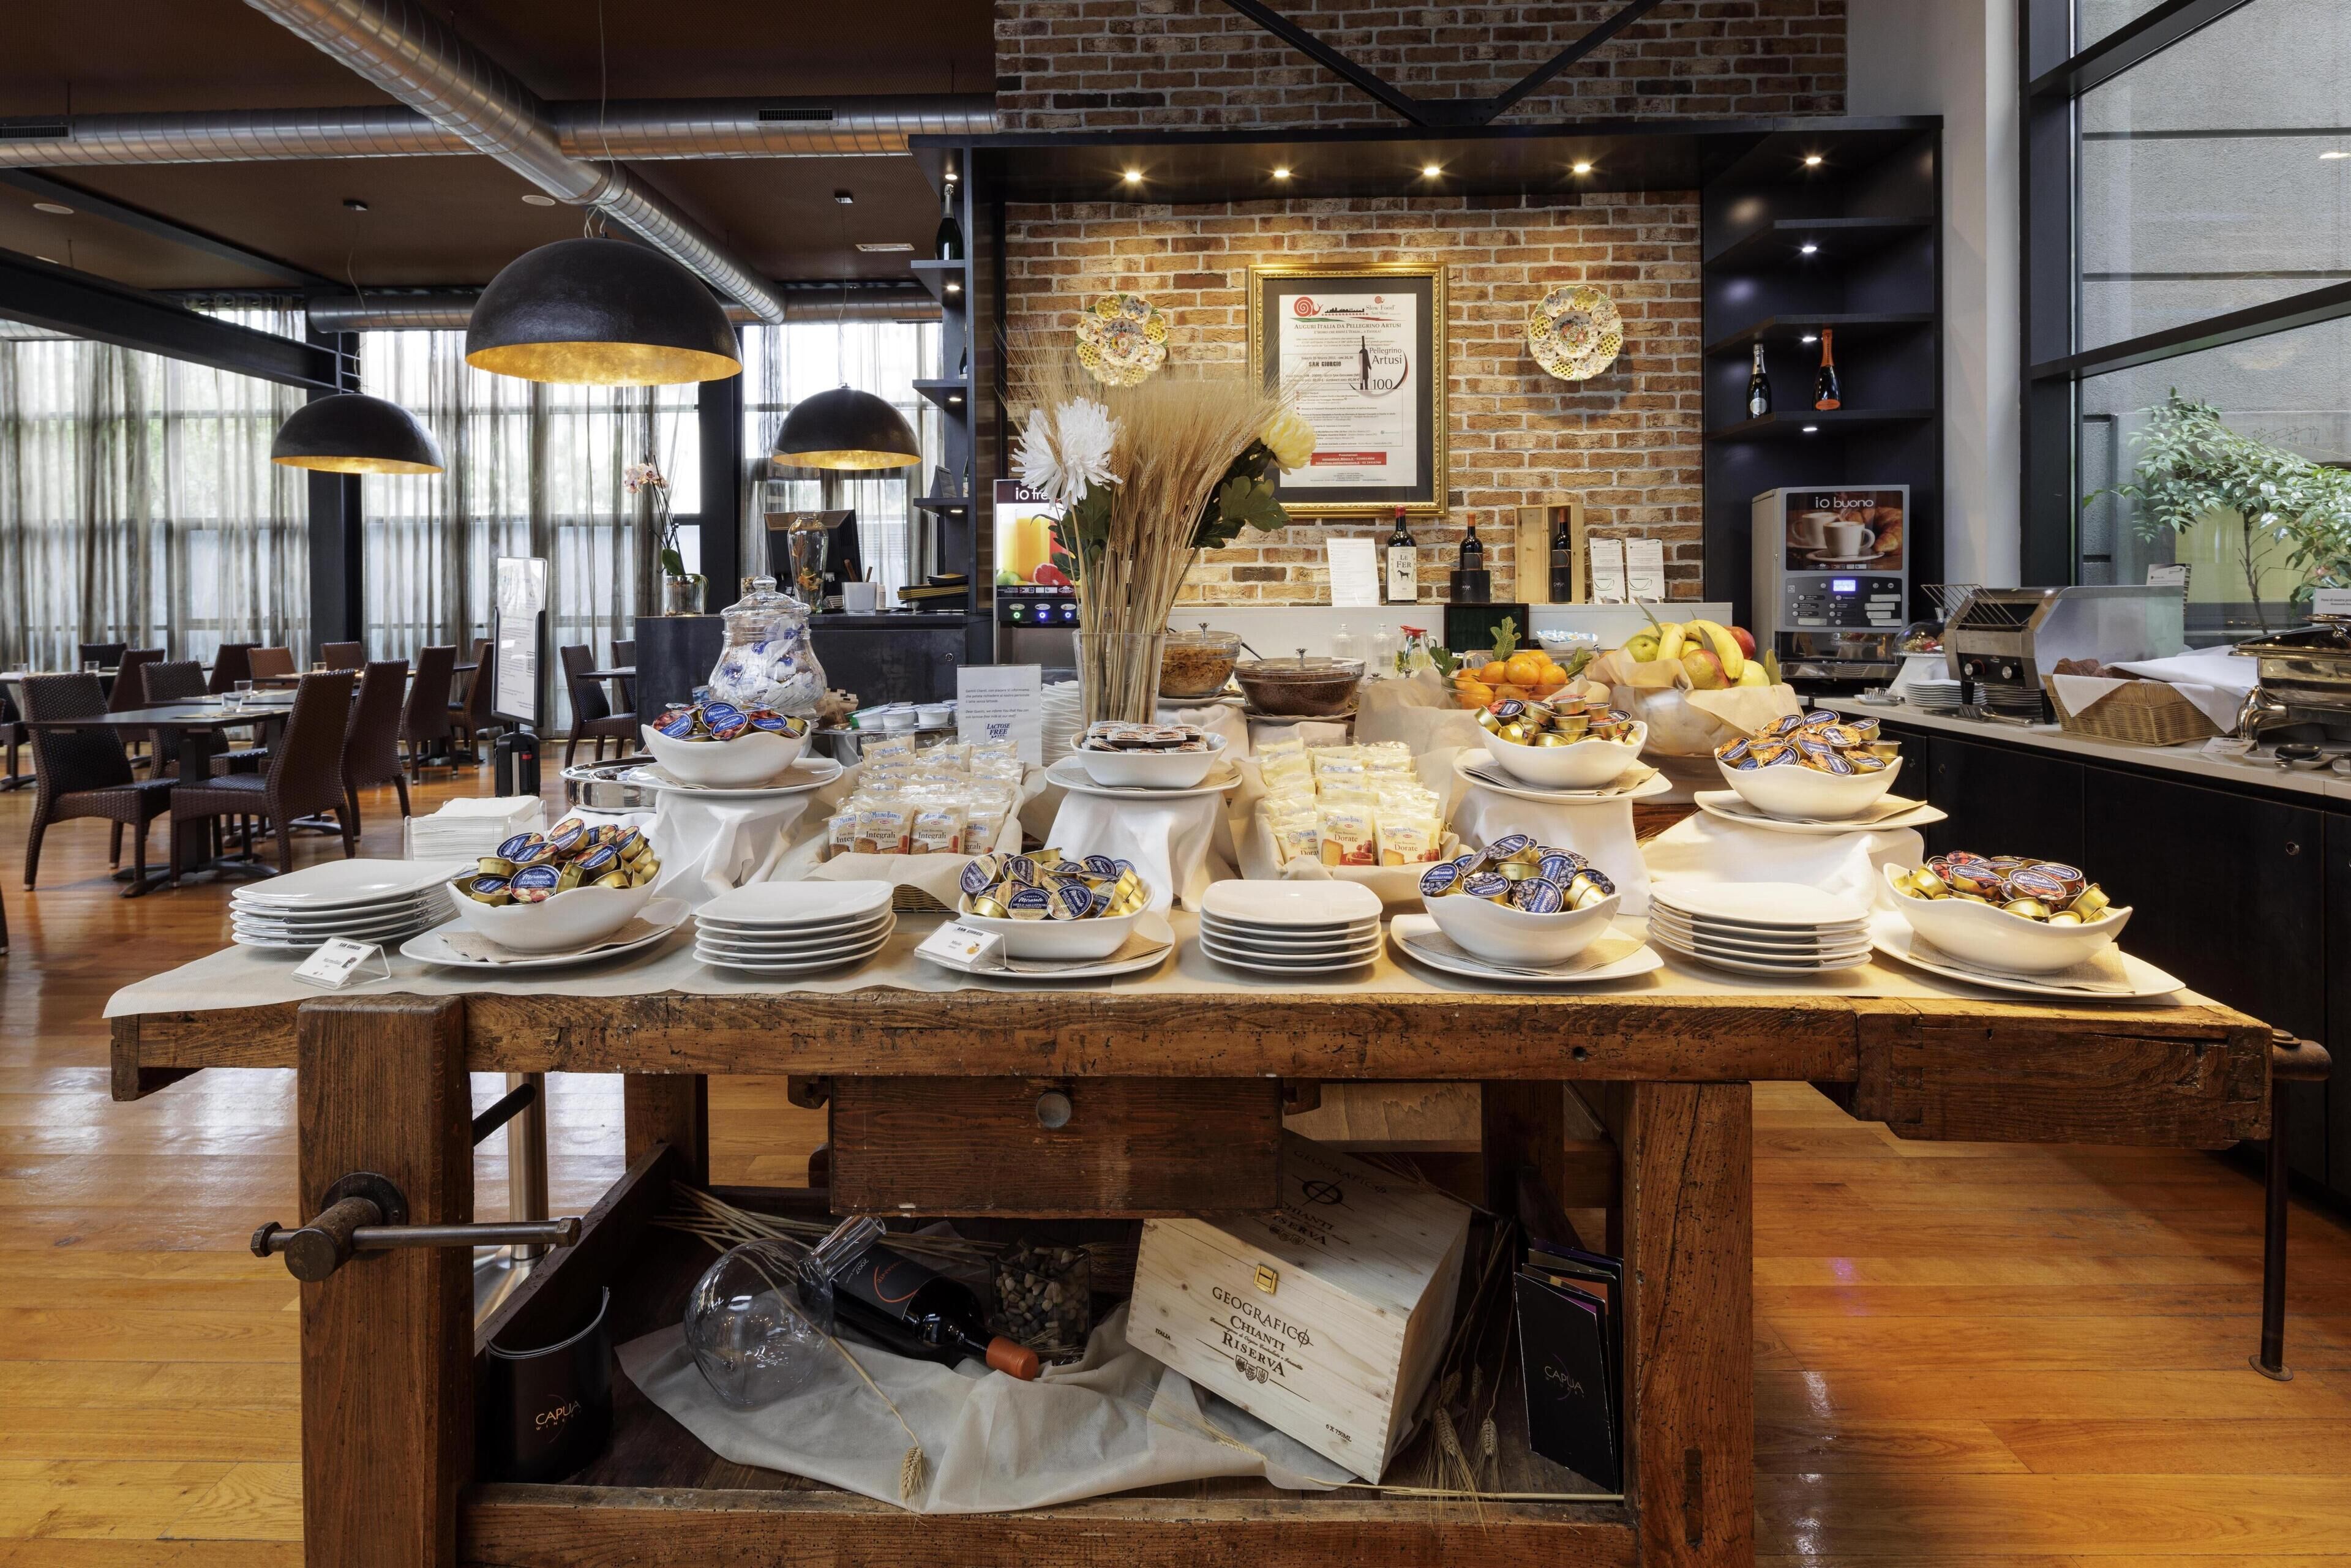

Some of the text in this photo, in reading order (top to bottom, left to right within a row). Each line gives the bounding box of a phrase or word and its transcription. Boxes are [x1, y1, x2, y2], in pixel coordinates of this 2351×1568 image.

[1372, 354, 1402, 364] Artusi
[1373, 378, 1392, 389] 100
[1015, 487, 1029, 500] io
[1815, 497, 1873, 508] io buono
[1335, 834, 1359, 842] Dorate
[1294, 1150, 1387, 1193] GEOGRAFICO
[1273, 1215, 1327, 1245] ISERVA
[856, 1258, 869, 1275] 2007
[1212, 1286, 1311, 1346] GEOGRAFICO
[1155, 1327, 1171, 1341] ITALIA
[1230, 1315, 1285, 1352] CHIANTI
[1221, 1331, 1286, 1378] RISERVA
[1244, 1336, 1258, 1346] Origine
[1259, 1343, 1280, 1358] Controllata
[1545, 1366, 1584, 1394] CAPUA
[536, 1401, 581, 1425] CAPUA
[1335, 1428, 1352, 1442] 750ML
